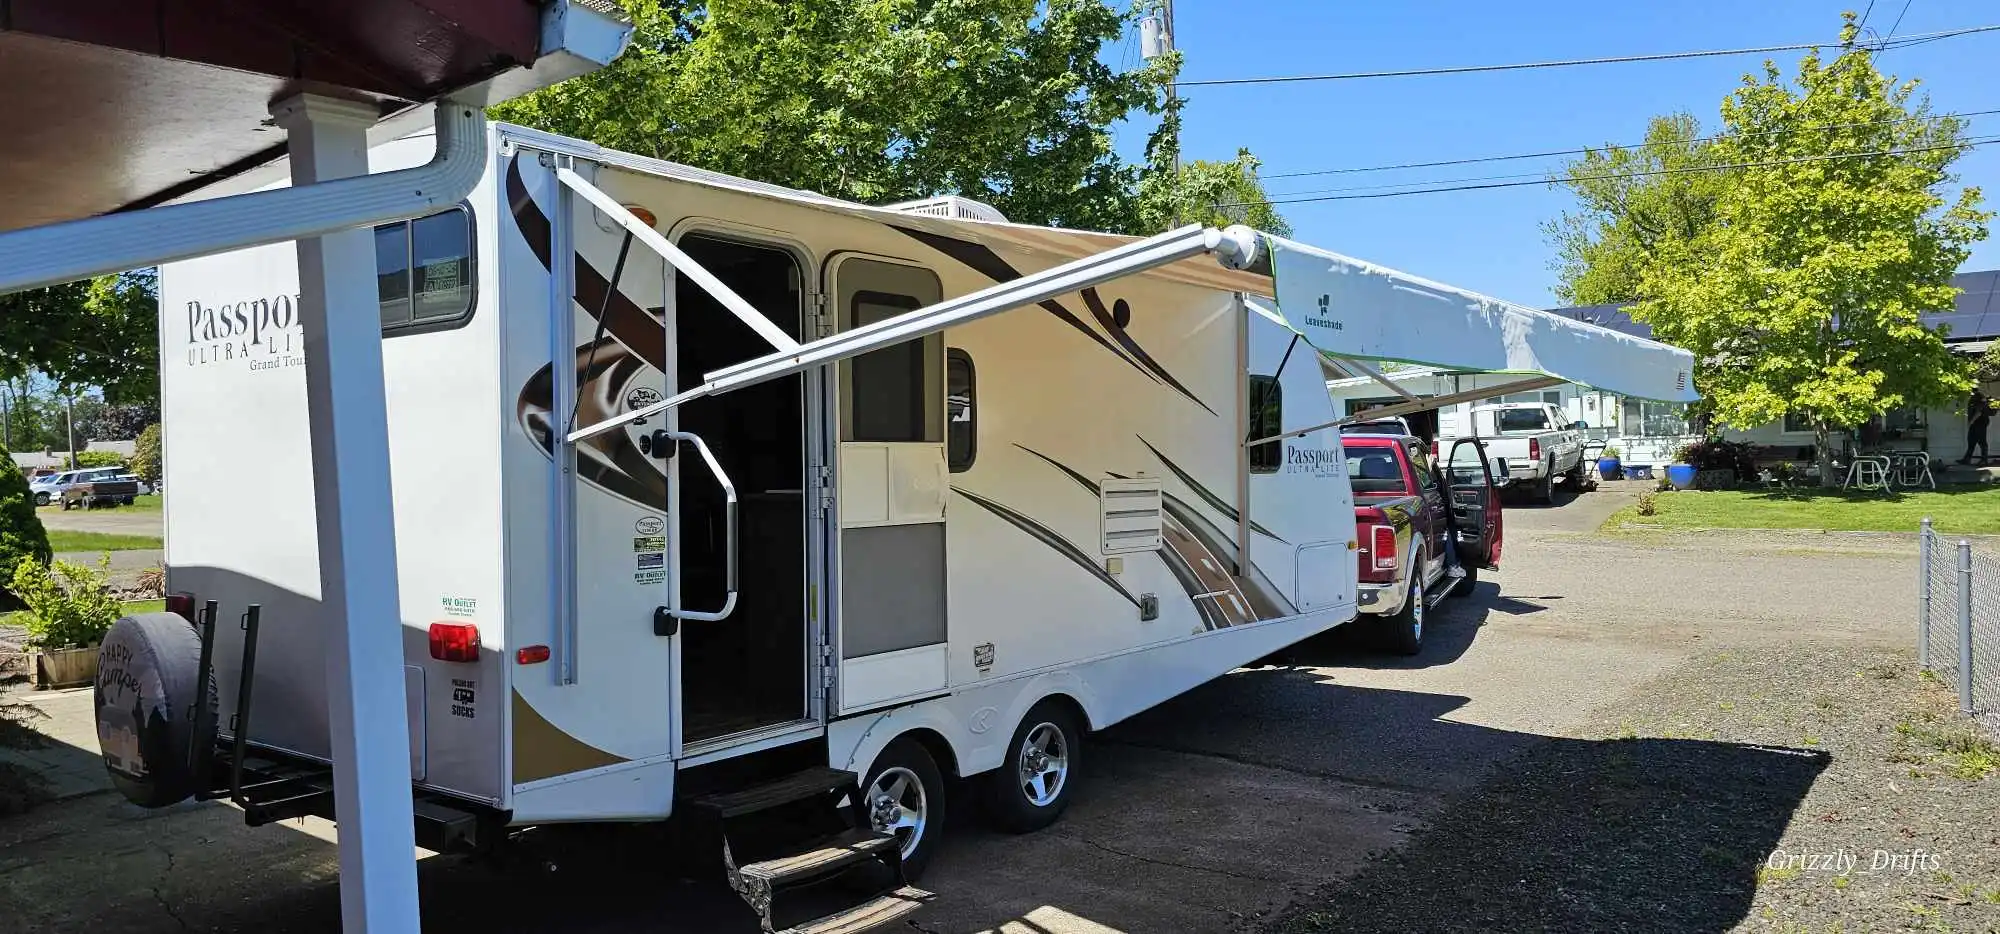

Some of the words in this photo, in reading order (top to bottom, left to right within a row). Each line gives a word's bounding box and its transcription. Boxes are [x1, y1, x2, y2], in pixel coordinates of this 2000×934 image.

[1305, 315, 1343, 331] Leaveshade
[188, 341, 248, 367] ULTRA
[269, 334, 304, 355] LI
[250, 356, 280, 371] Grand
[283, 355, 306, 367] Tou
[1287, 445, 1339, 469] Passport
[1287, 464, 1315, 474] ULTRA
[1321, 463, 1340, 473] LITE
[442, 597, 452, 606] RV
[105, 643, 133, 666] HAPPY
[96, 652, 143, 698] Camper
